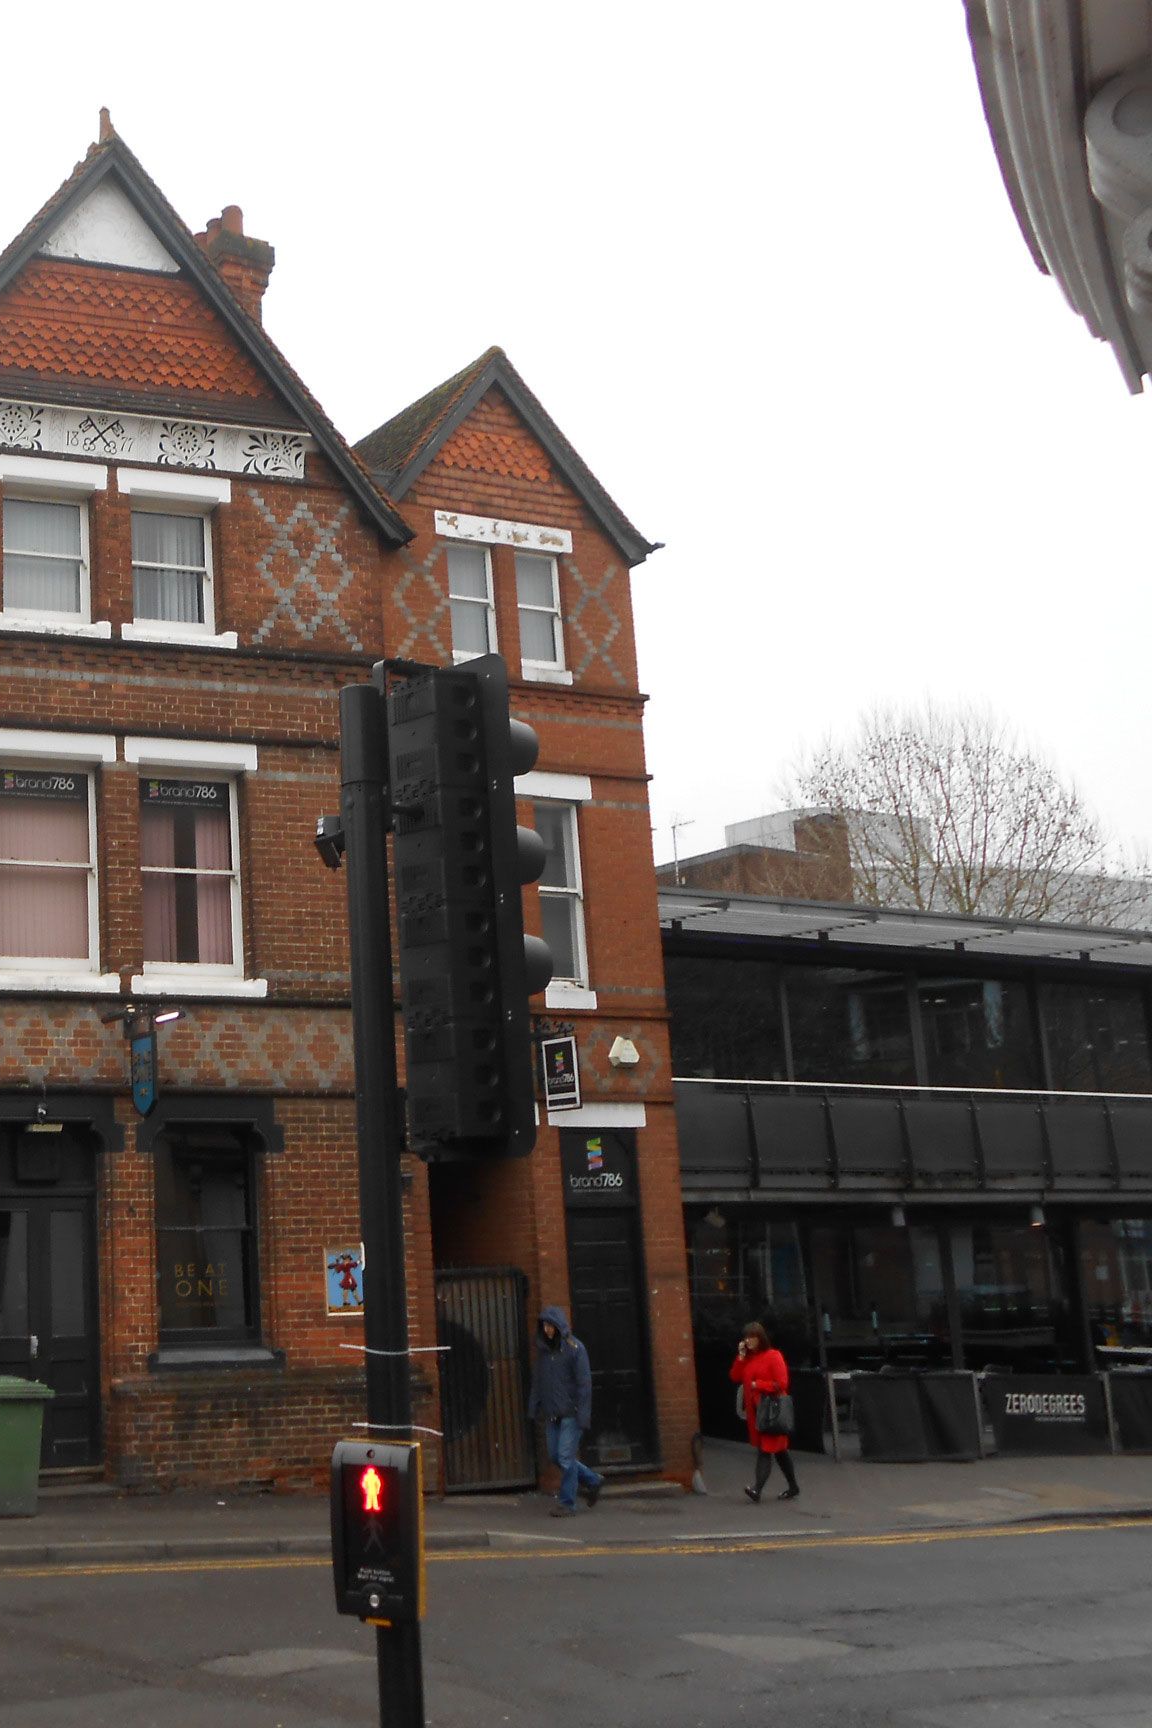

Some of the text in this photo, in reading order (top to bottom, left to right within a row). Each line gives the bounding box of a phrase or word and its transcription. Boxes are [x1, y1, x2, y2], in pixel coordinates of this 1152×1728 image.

[66, 430, 79, 446] 18
[16, 774, 75, 790] brand786
[160, 784, 217, 799] brand786
[569, 1172, 623, 1187] brand786
[175, 1263, 226, 1277] BE AT
[176, 1279, 229, 1297] ONE
[1005, 1393, 1086, 1414] ZERODEGREES
